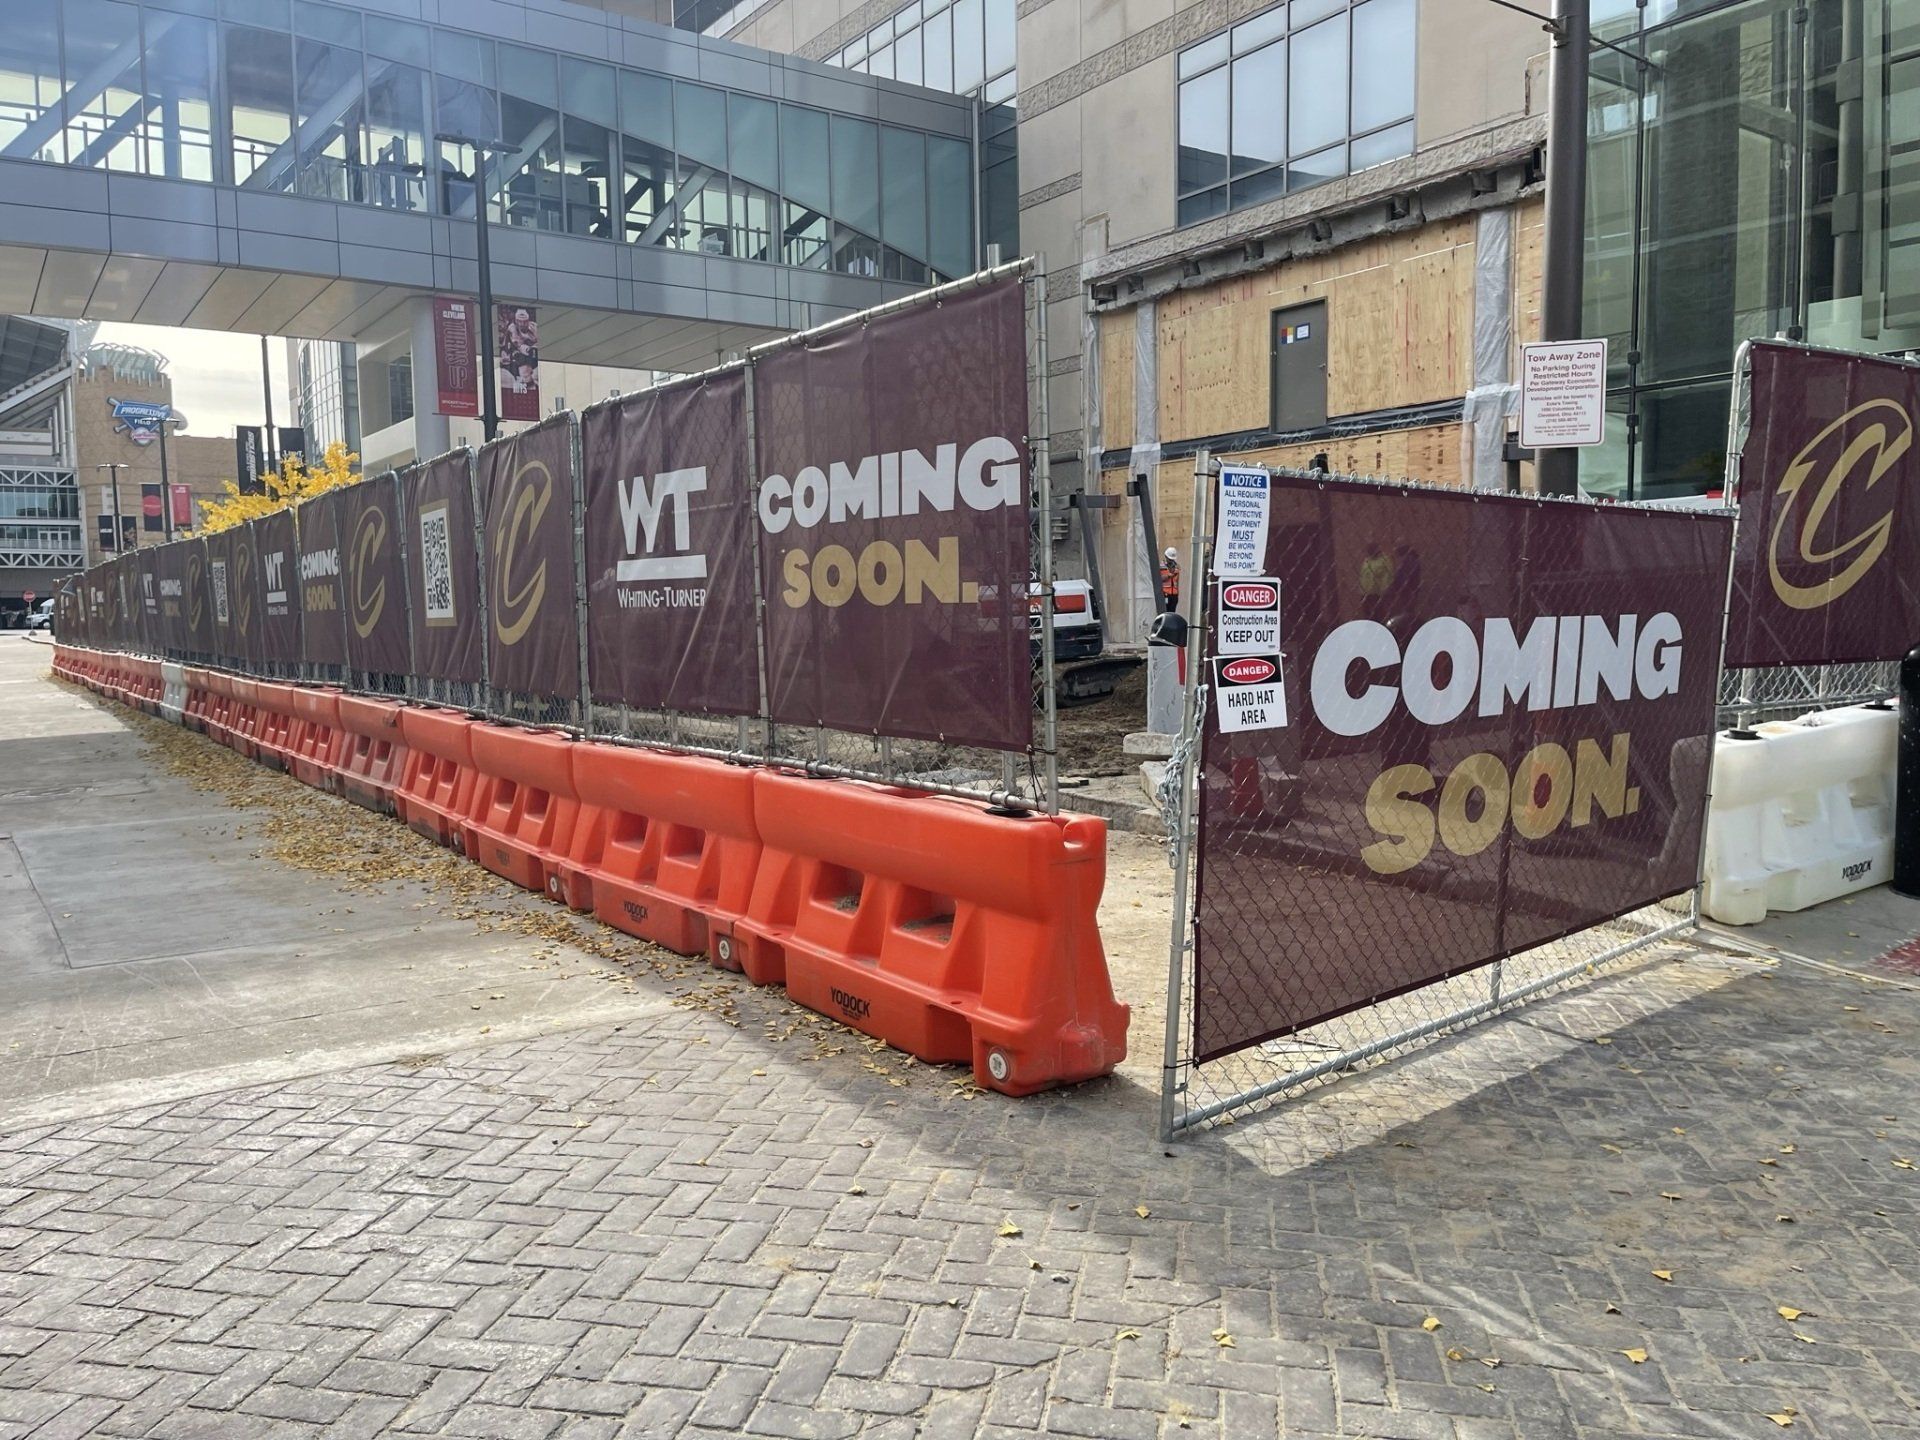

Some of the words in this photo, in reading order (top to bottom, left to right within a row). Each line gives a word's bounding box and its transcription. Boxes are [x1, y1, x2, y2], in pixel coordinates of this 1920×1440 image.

[1528, 354, 1546, 362] Tow
[758, 436, 1022, 535] COMING
[1230, 475, 1262, 487] NOTICE
[1224, 490, 1236, 498] ALL
[1238, 491, 1266, 499] REQUIRED
[617, 465, 707, 555] WT
[1230, 500, 1261, 508] PERSONAL
[1227, 510, 1262, 518] PROTECTIVE
[1228, 520, 1260, 528] EQUIPMENT
[1232, 530, 1254, 540] MUST
[1228, 542, 1236, 550] BE
[1228, 552, 1253, 560] BEYOND
[264, 551, 284, 591] WT
[302, 548, 339, 580] COMING
[782, 536, 980, 609] SOON.
[306, 584, 336, 612] SOON.
[1231, 590, 1270, 603] DANGER
[1222, 614, 1264, 626] Construction
[1264, 614, 1278, 625] Area
[1226, 630, 1252, 642] KEEP
[1254, 630, 1274, 642] OUT
[1229, 666, 1269, 676] DANGER
[1311, 611, 1683, 737] COMING
[1228, 692, 1254, 708] HARD
[1256, 690, 1274, 705] HAT
[1241, 709, 1267, 725] AREA
[1360, 732, 1641, 875] SOON.
[1842, 858, 1872, 879] YODOCK
[624, 901, 648, 920] YODOCK
[831, 986, 870, 1018] YODOCK
